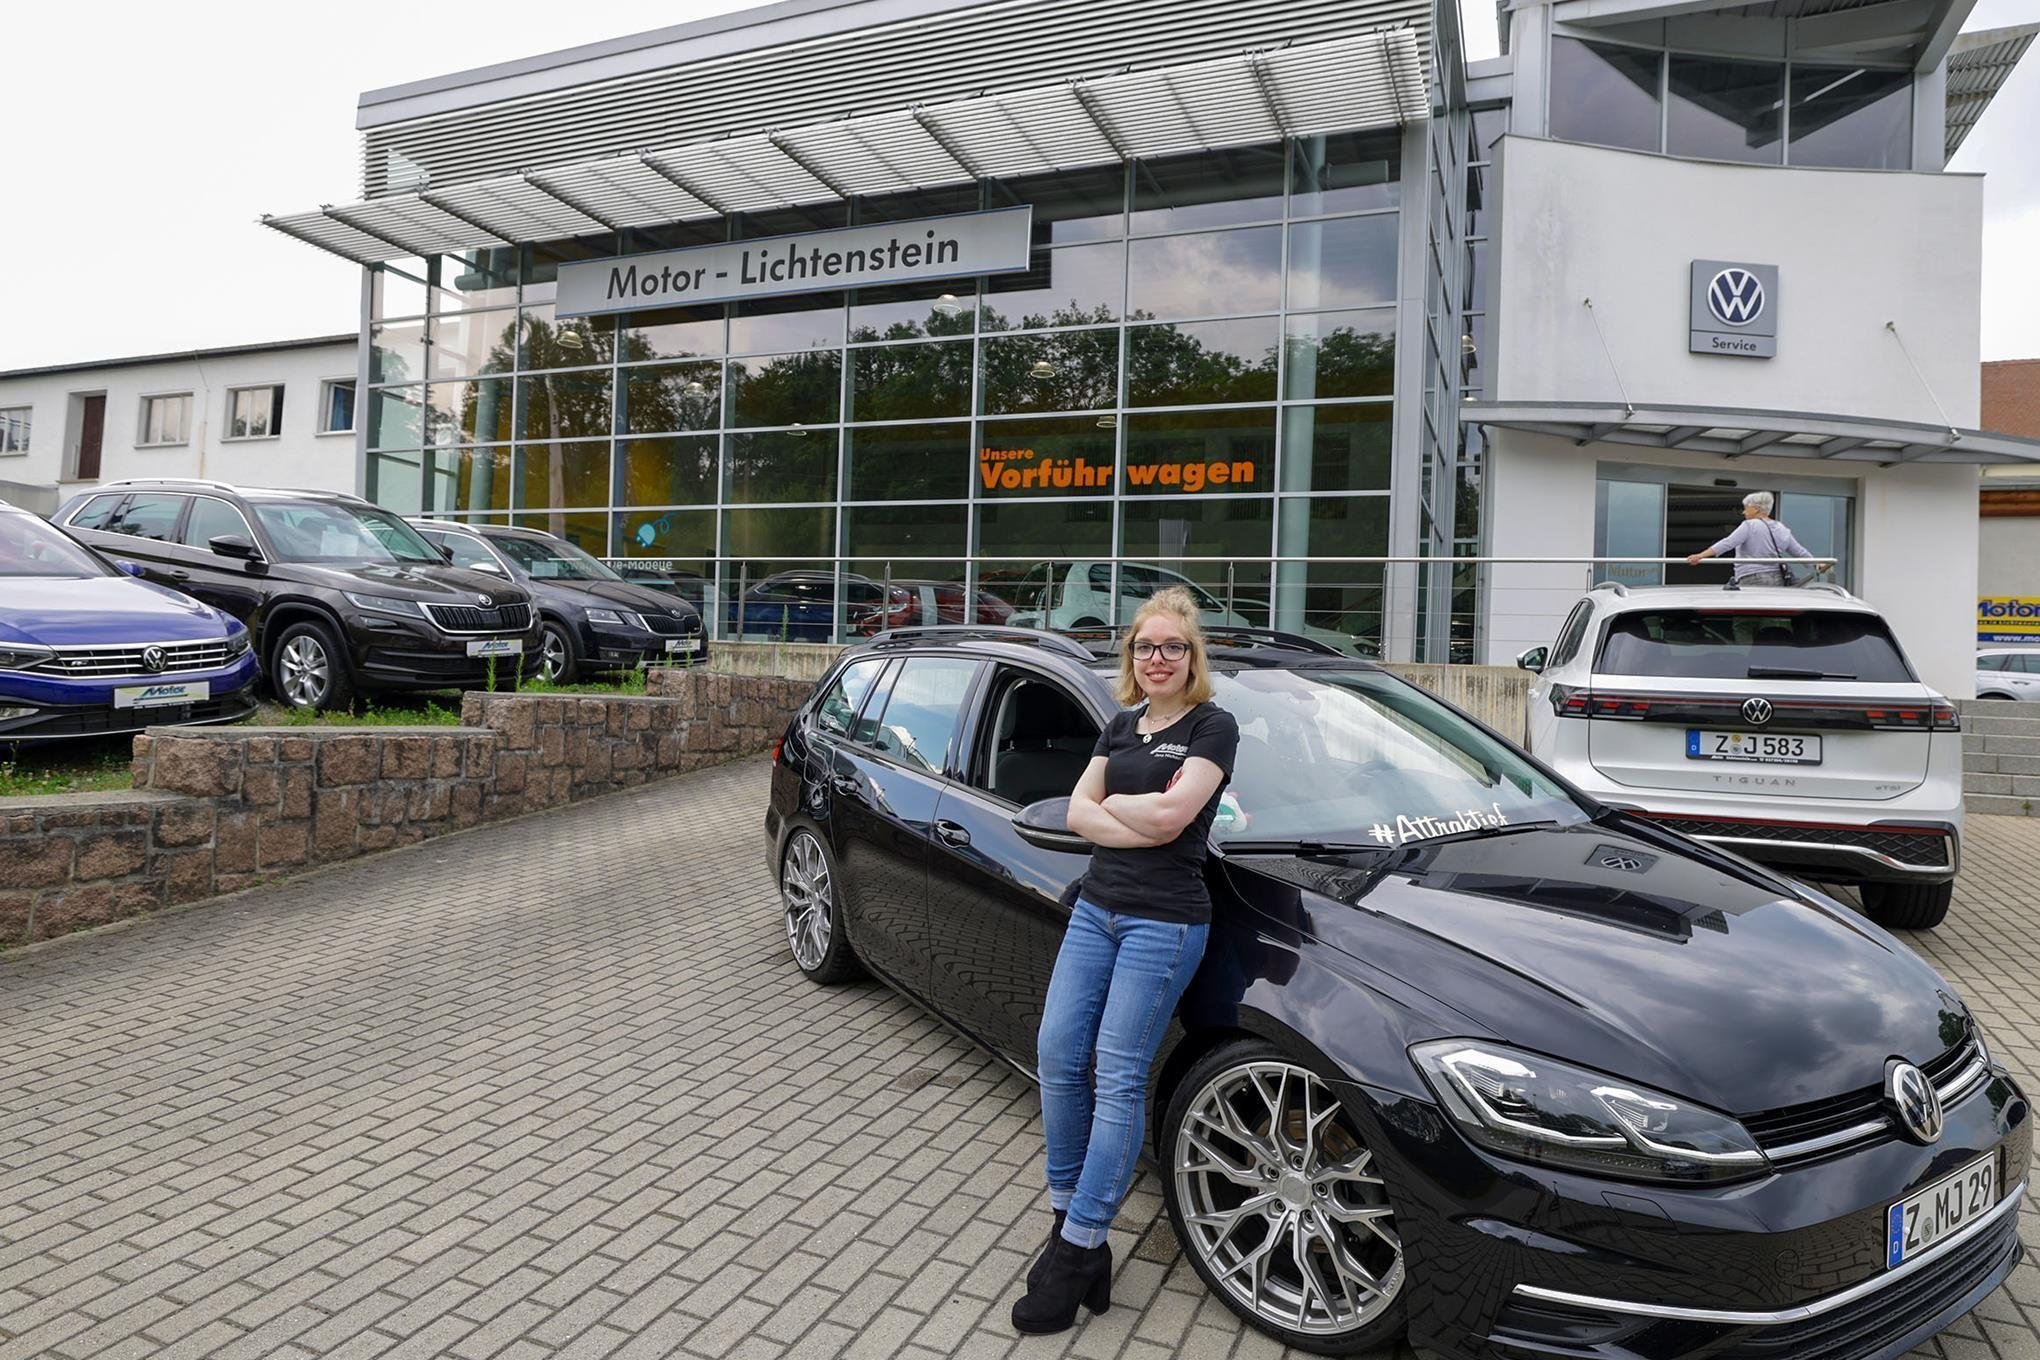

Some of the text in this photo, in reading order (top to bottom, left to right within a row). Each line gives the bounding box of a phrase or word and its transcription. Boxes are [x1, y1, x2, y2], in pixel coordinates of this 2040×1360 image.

[607, 264, 706, 299] Motor
[741, 230, 959, 285] Lichtenstein
[1712, 337, 1757, 351] Service
[980, 448, 1034, 461] Unsere
[141, 686, 186, 698] Motor
[1715, 735, 1729, 754] Z
[1744, 737, 1757, 755] J
[1763, 737, 1804, 756] 583
[1712, 775, 1796, 787] TIGUAN
[1905, 1203, 1920, 1250] Z
[1935, 1180, 1963, 1235] MJ
[1968, 1165, 1992, 1215] 29
